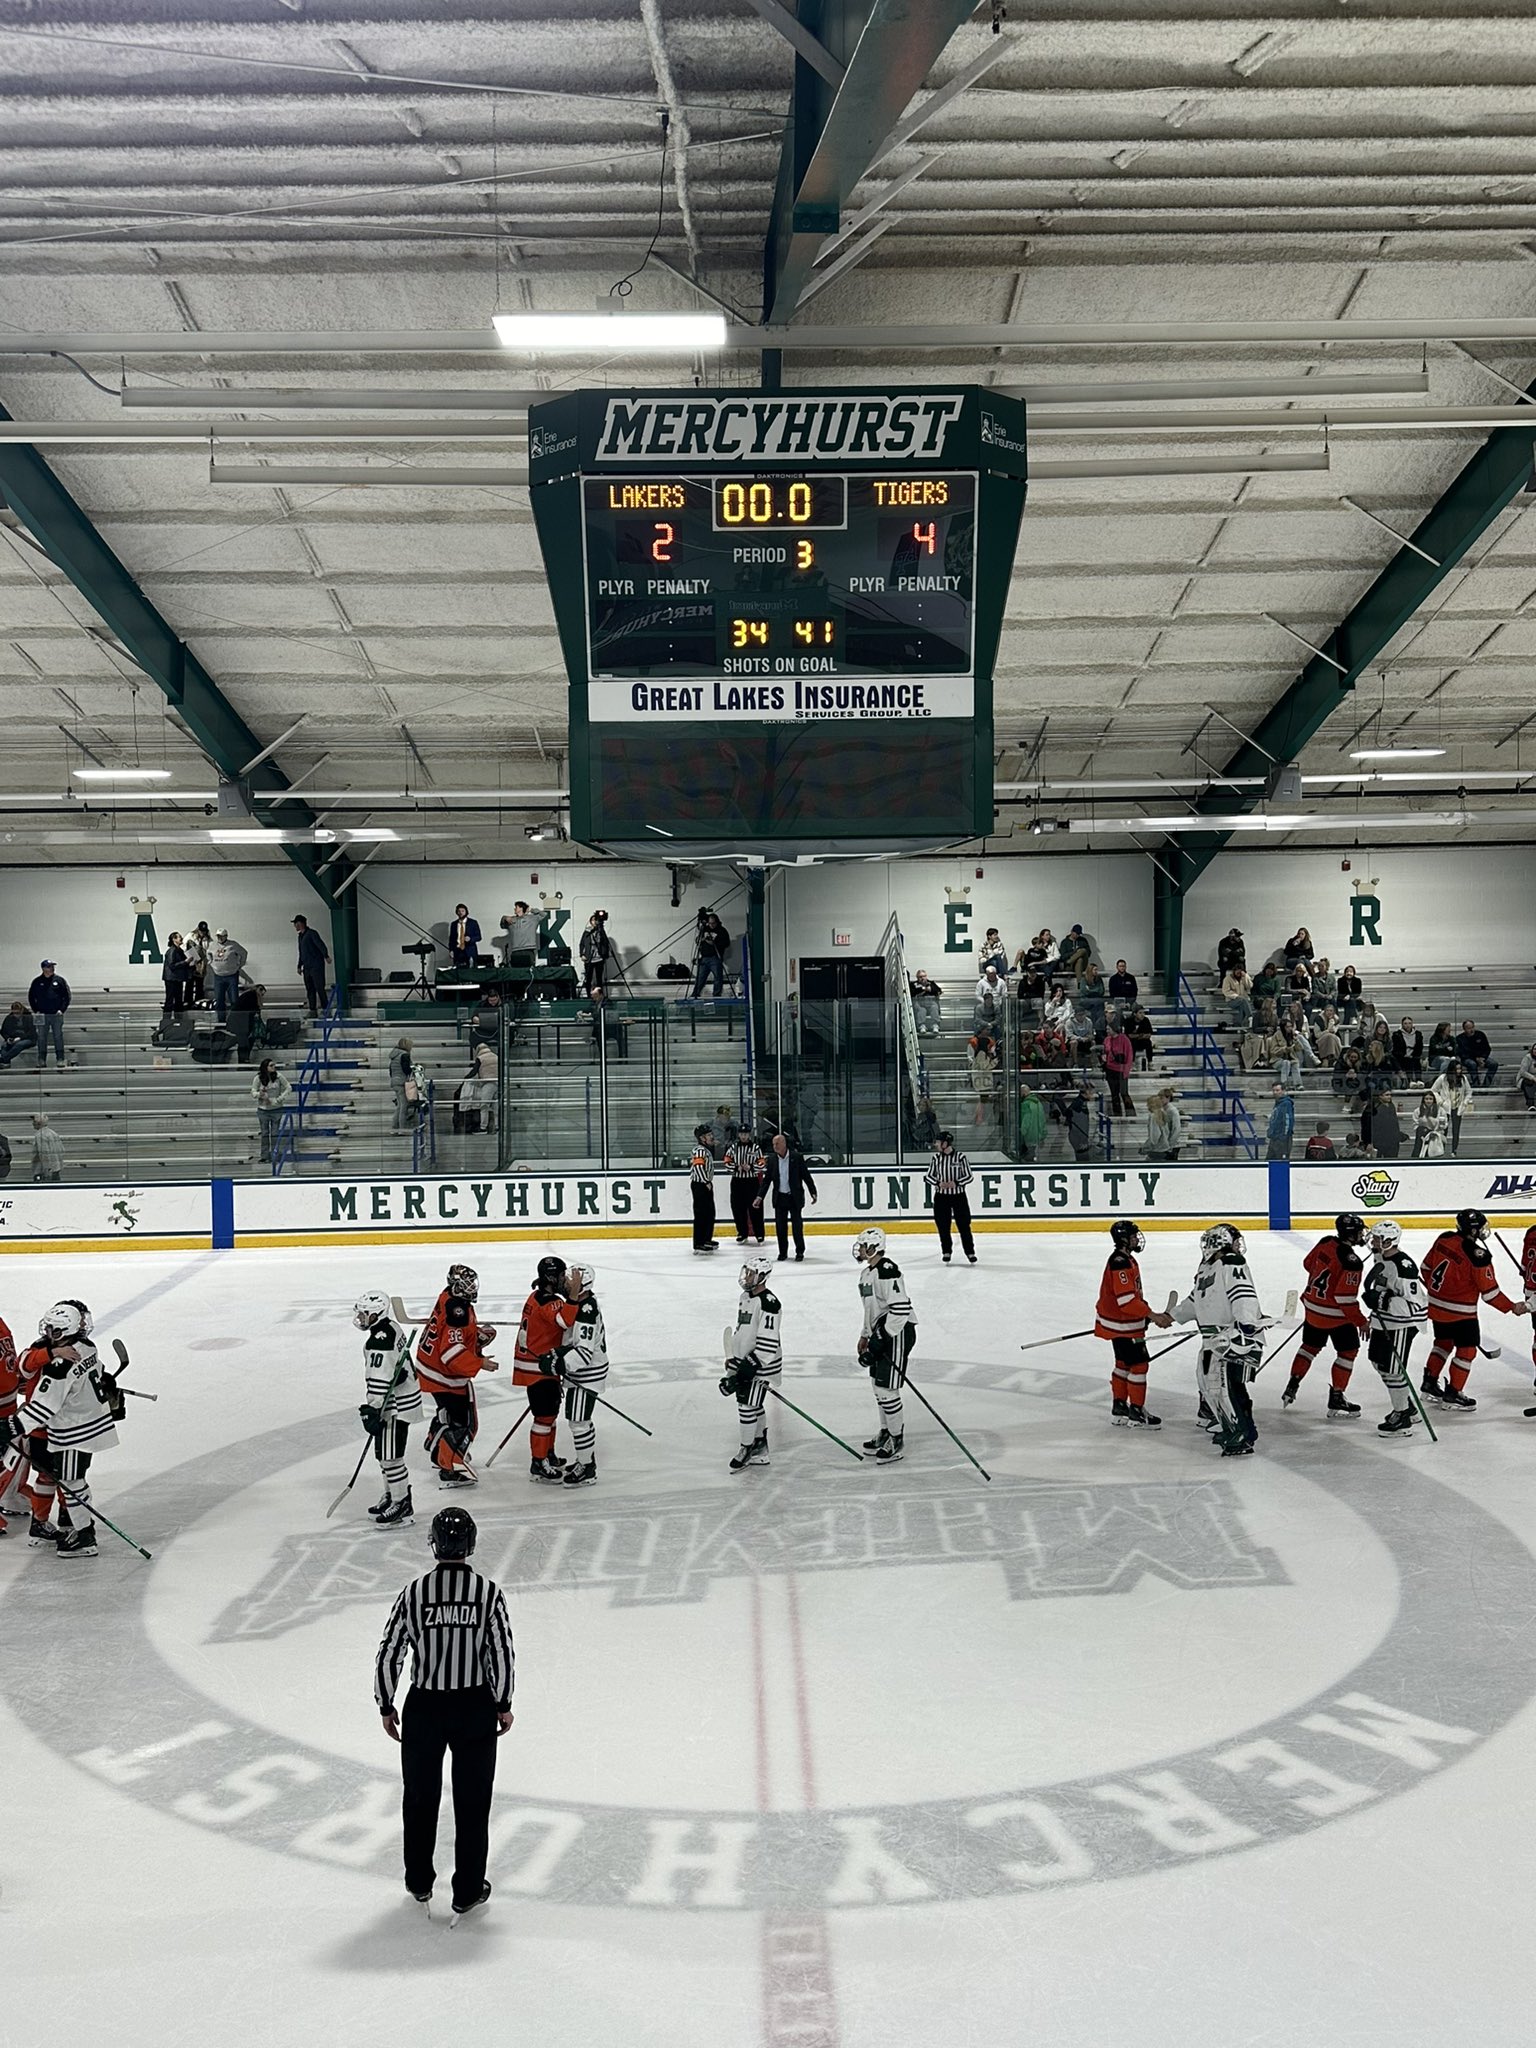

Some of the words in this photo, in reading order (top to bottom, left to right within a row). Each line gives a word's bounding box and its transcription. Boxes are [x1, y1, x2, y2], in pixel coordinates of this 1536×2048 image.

[597, 396, 963, 460] MERCYHURST
[609, 484, 685, 508] LAKERS
[722, 483, 812, 523] 00.0
[873, 481, 948, 505] TIGERS
[652, 523, 674, 561] 2
[913, 522, 936, 555] 4
[733, 547, 787, 564] PERIOD
[797, 540, 812, 569] 3
[598, 579, 635, 596] PLYR
[648, 578, 711, 595] PENALTY
[850, 576, 885, 593] PLYR
[898, 575, 961, 592] PENALTY
[733, 619, 768, 647] 34
[795, 621, 833, 644] 41
[723, 657, 770, 673] SHOTS
[775, 657, 795, 673] ON
[799, 656, 837, 672] GOAL
[632, 683, 703, 711] GREAT
[713, 682, 785, 710] LAKES
[795, 682, 924, 710] INSURANCE
[795, 710, 855, 718] SERVICES
[908, 709, 932, 717] LLC
[944, 904, 972, 952] E
[1350, 896, 1382, 946] R
[129, 915, 163, 964] A
[537, 910, 571, 959] K
[836, 934, 851, 944] EXIT
[852, 1172, 1160, 1210] UNIERSITY
[1352, 1175, 1400, 1201] Starry
[1484, 1175, 1536, 1199] AH
[330, 1180, 666, 1221] MERCYHURST
[1119, 1271, 1129, 1284] 9
[1232, 1267, 1247, 1280] 44
[1345, 1271, 1360, 1287] 14
[1430, 1259, 1450, 1292] 4
[1485, 1266, 1494, 1281] 4
[892, 1279, 901, 1293] 4
[1409, 1281, 1418, 1295] 9
[580, 1325, 594, 1341] 39
[764, 1315, 775, 1330] 11
[447, 1328, 464, 1344] 32
[370, 1352, 384, 1368] 10
[38, 1377, 52, 1393] 6
[425, 1605, 477, 1626] ZAWADA
[76, 1691, 1483, 1907] MERCYHURST
